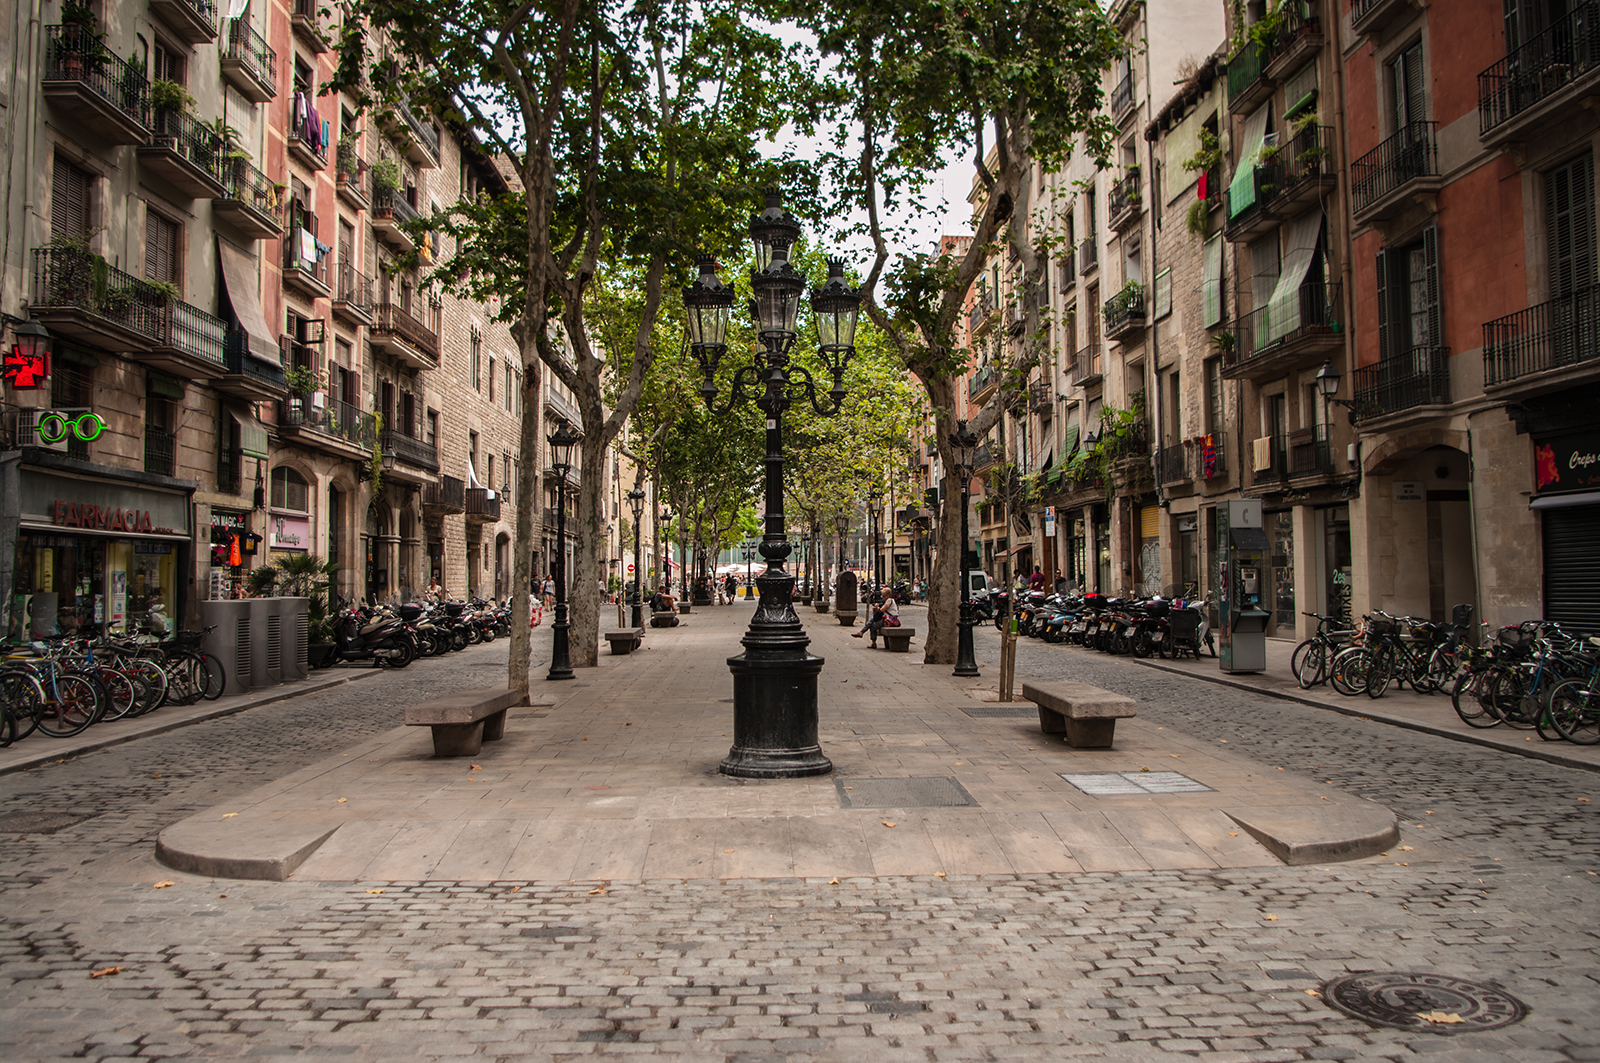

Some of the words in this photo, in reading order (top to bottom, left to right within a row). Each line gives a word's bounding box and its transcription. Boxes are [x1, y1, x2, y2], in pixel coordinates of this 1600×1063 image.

[53, 499, 153, 534] FARMACIA
[221, 515, 237, 528] MAGIC
[1332, 568, 1346, 585] 2es
[1342, 584, 1352, 631] EBAIXES
